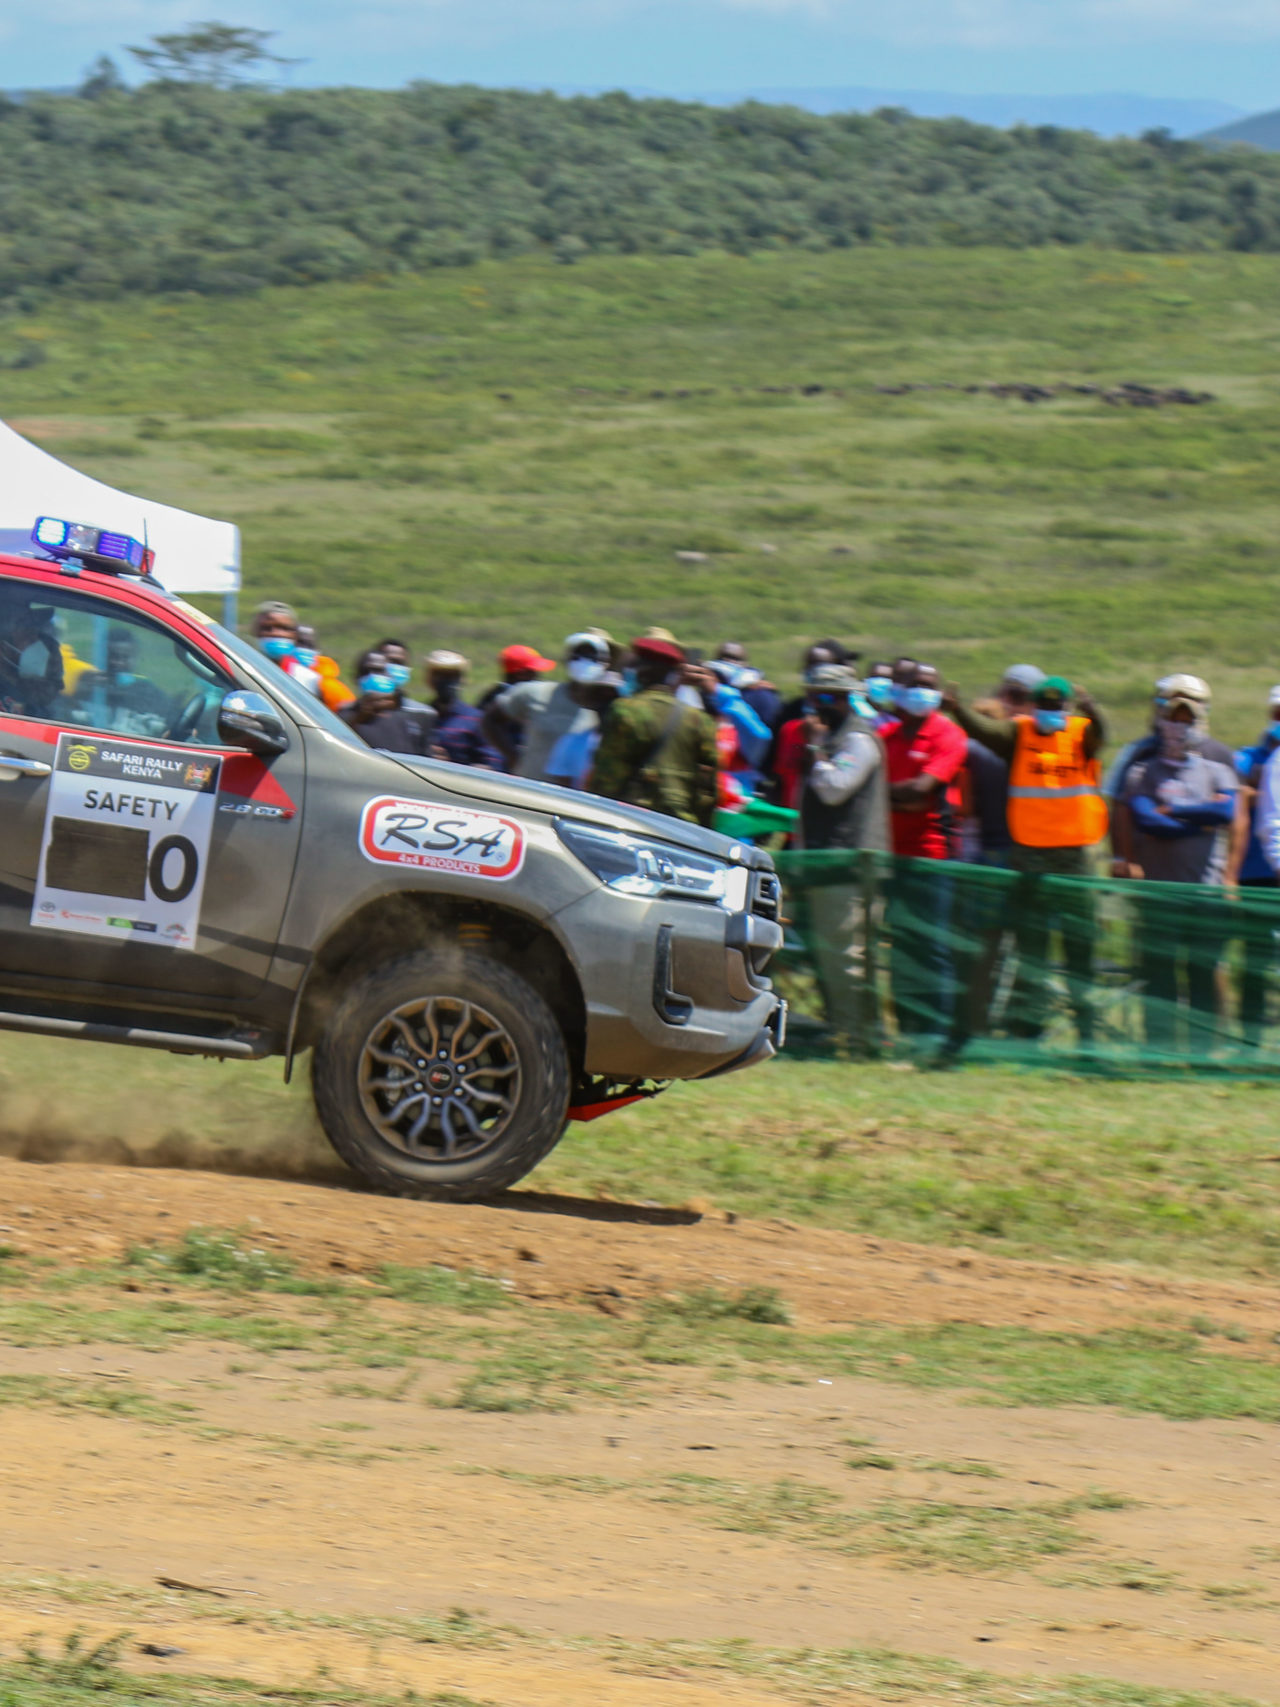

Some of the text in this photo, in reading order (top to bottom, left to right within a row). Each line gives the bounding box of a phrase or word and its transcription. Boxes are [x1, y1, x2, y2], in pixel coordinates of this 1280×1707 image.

[101, 751, 183, 771] SAFARI RALLY
[122, 764, 162, 779] KENYA
[83, 789, 179, 821] SAFETY
[380, 813, 506, 857] RSA
[149, 834, 199, 903] 0
[398, 853, 481, 874] 4x4 PRODUCTS
